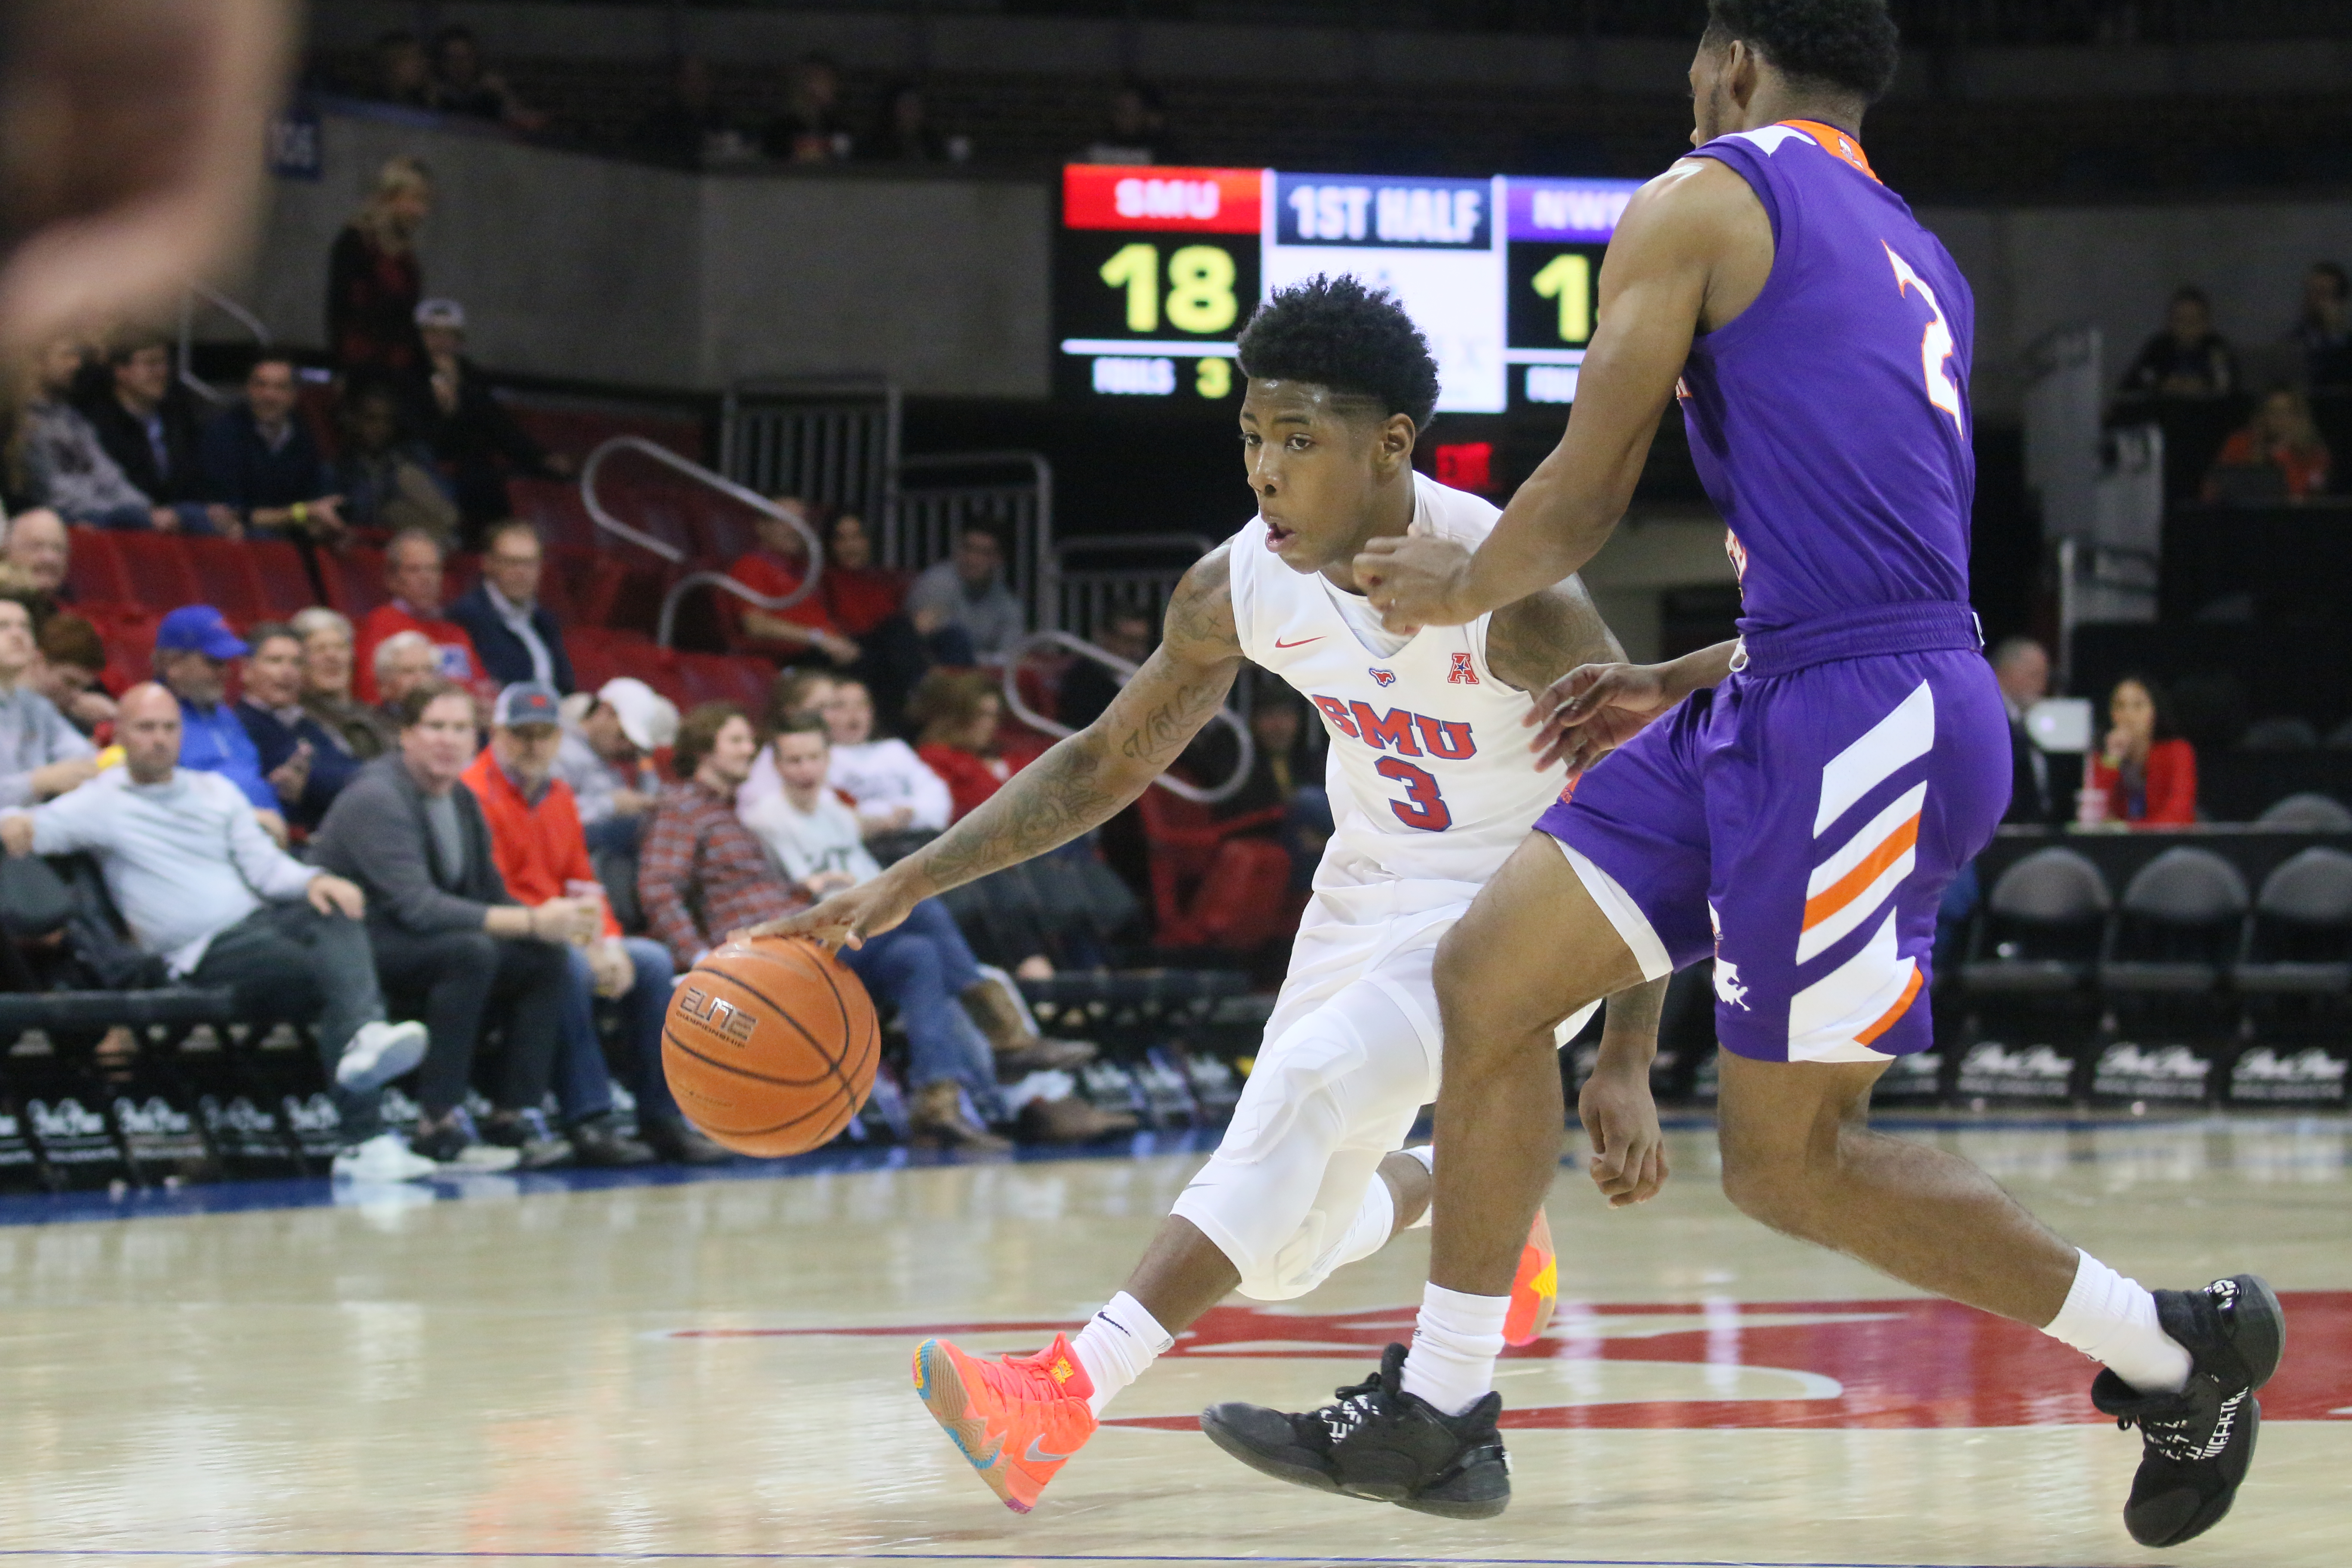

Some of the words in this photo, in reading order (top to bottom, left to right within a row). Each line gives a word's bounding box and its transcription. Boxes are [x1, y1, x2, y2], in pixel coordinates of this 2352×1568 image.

[1115, 178, 1220, 220] SMU
[1288, 185, 1372, 239] 1ST
[1377, 187, 1482, 243] HALF
[1099, 242, 1238, 334] 18
[1880, 239, 1963, 441] 2
[1196, 357, 1232, 399] 3
[1312, 694, 1477, 760] SMU
[1374, 755, 1452, 832] 3
